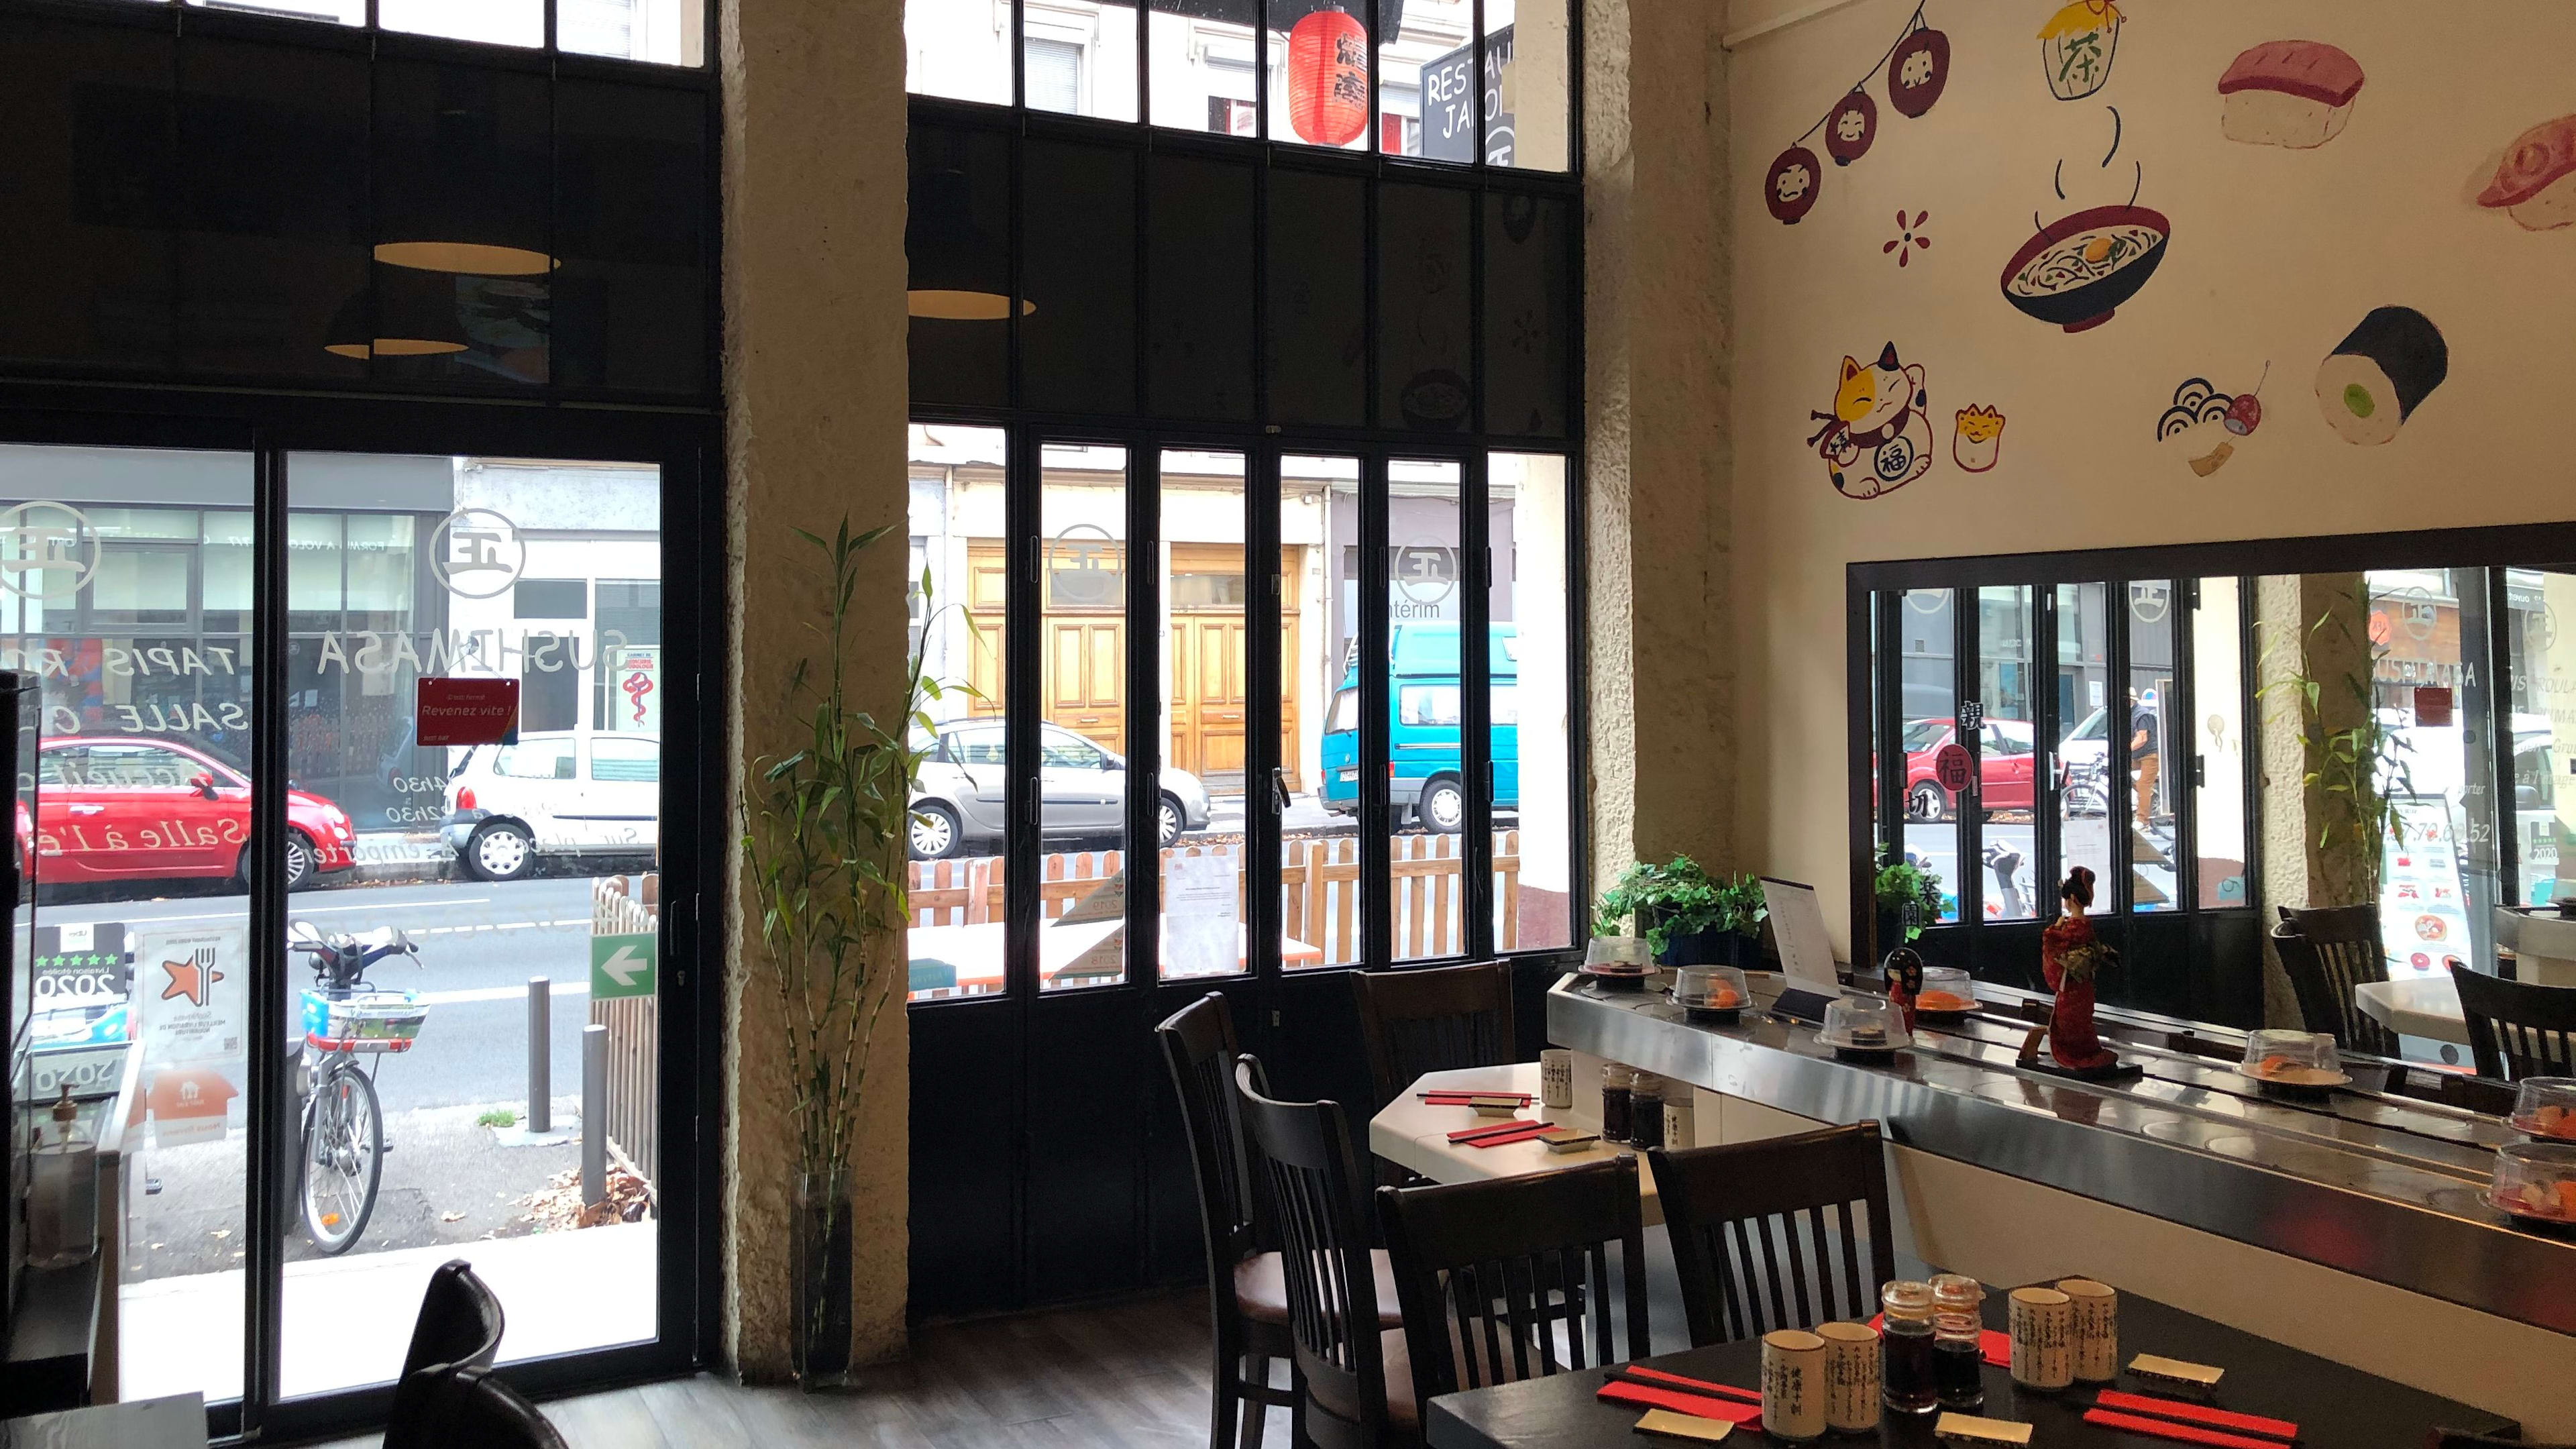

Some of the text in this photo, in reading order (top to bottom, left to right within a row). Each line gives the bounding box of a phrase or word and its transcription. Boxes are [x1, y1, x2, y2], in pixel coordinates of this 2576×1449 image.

[2059, 31, 2102, 83] 茶
[1880, 443, 1907, 473] 福
[422, 704, 478, 716] Revenez
[480, 704, 504, 716] vite
